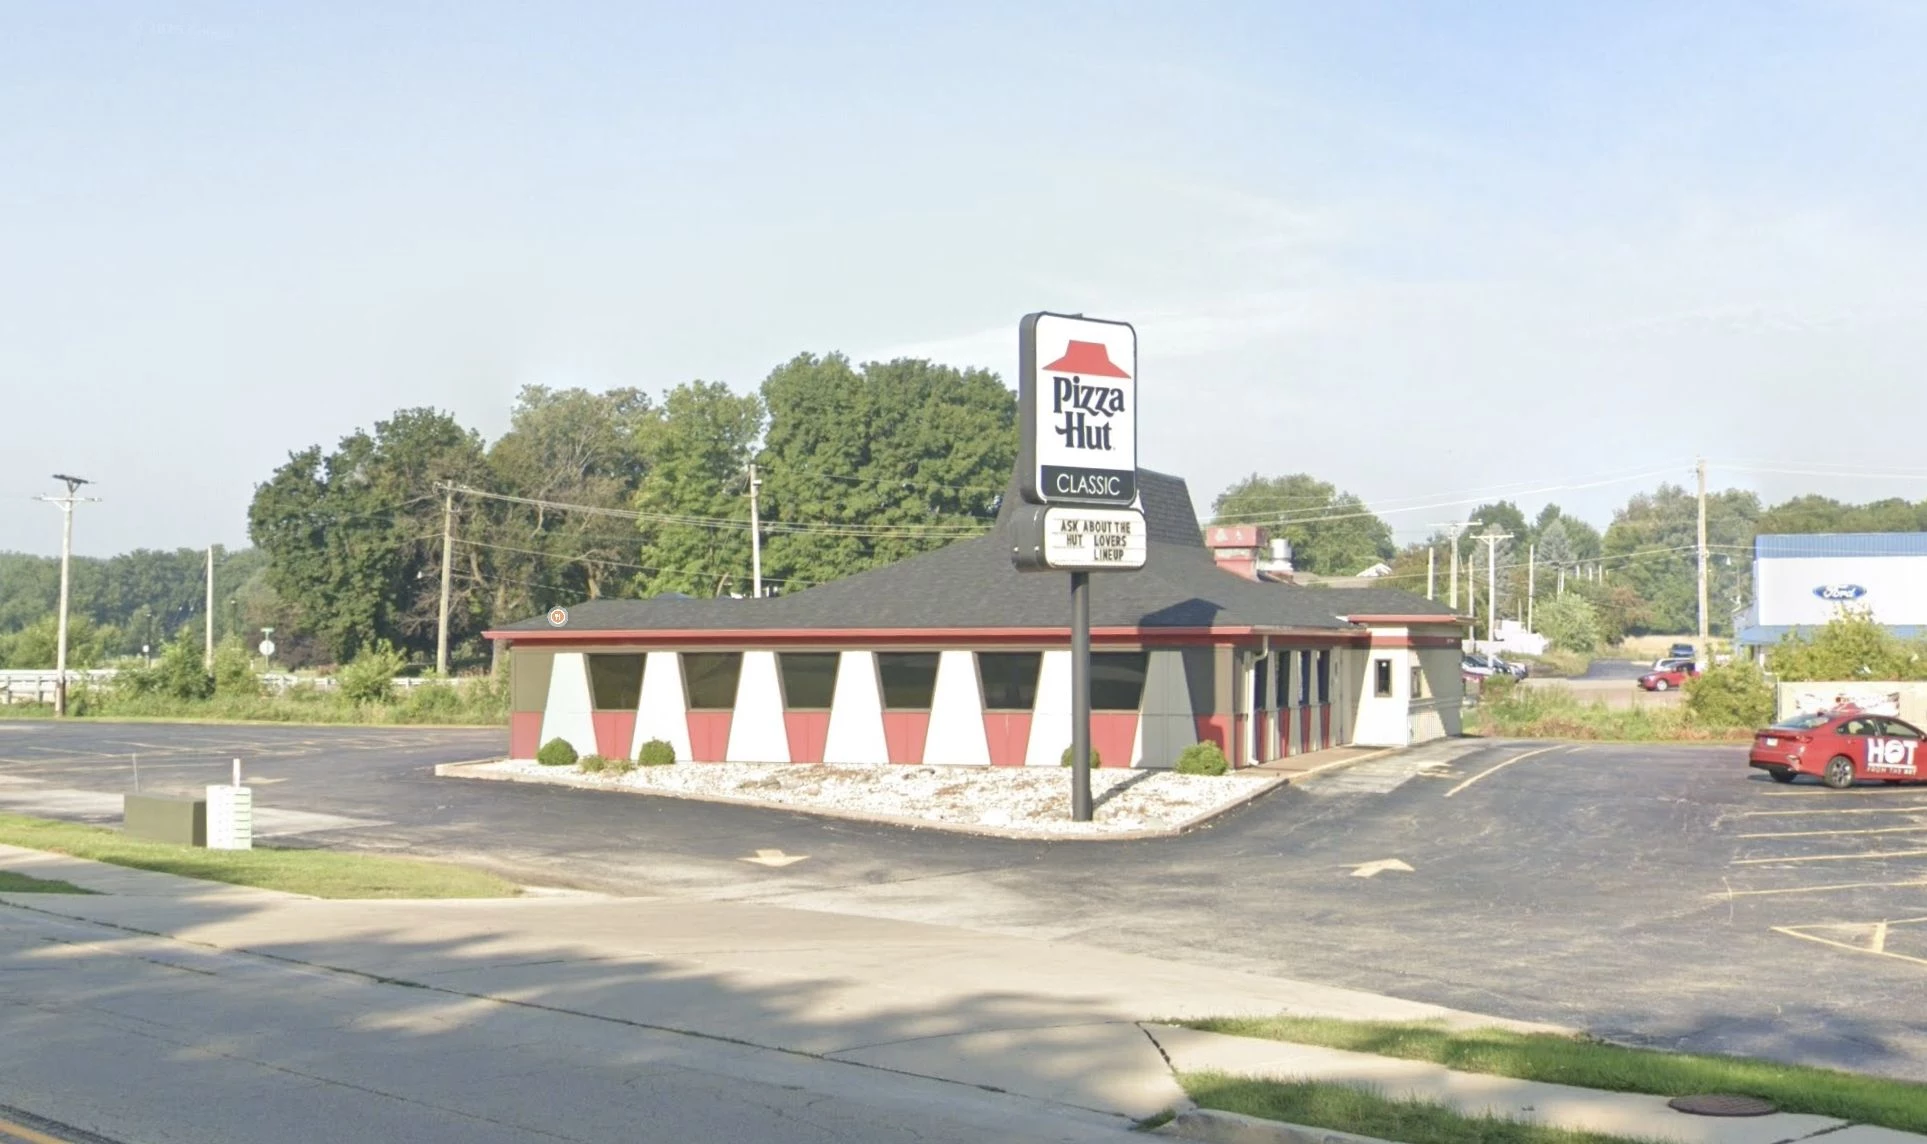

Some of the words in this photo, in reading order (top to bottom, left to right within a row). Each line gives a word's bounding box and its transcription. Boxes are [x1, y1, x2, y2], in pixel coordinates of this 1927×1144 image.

[1053, 376, 1125, 417] Pizza
[1055, 412, 1113, 451] Hut
[1056, 474, 1121, 496] CLASSIC
[1061, 520, 1078, 532] ASK
[1083, 520, 1112, 533] ABOUT
[1114, 521, 1131, 534] THE
[1066, 534, 1083, 546] HUT
[1094, 535, 1127, 547] LOVERS
[1094, 548, 1124, 561] LINEUP
[1867, 738, 1918, 765] HOT
